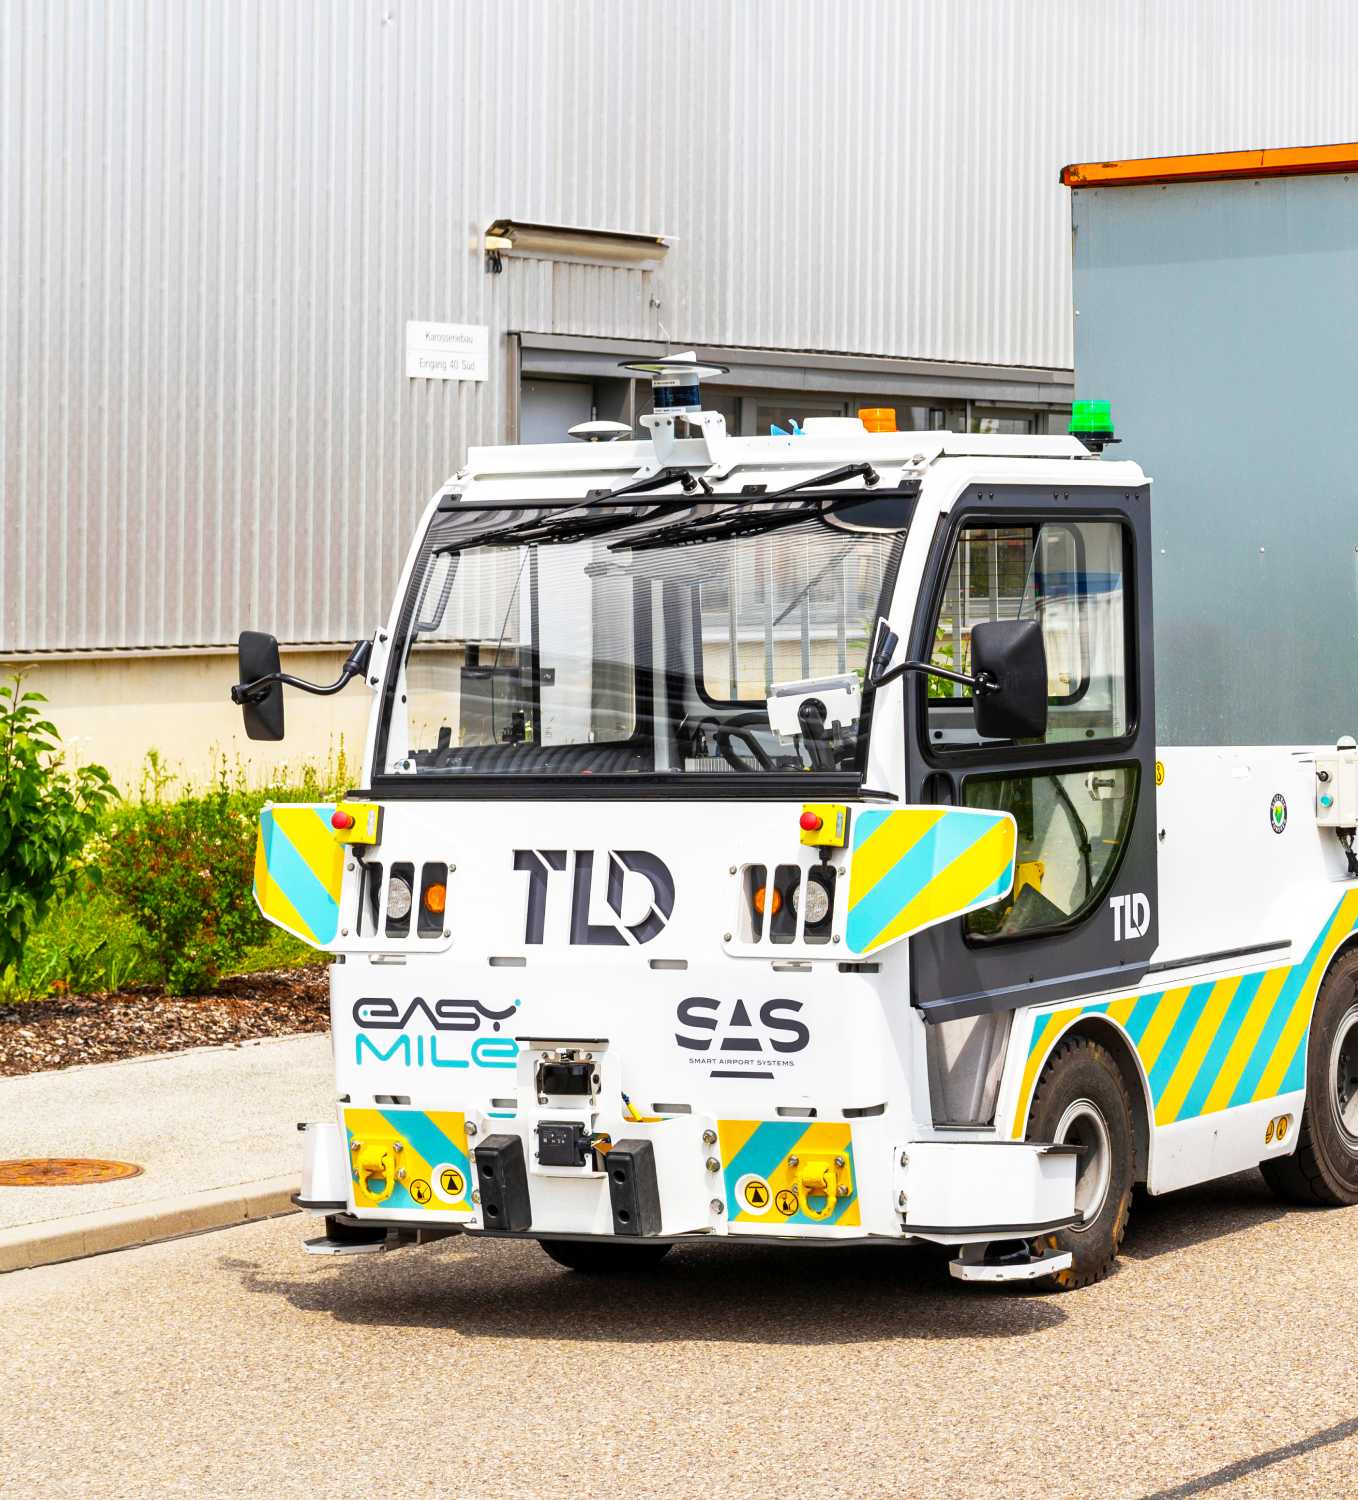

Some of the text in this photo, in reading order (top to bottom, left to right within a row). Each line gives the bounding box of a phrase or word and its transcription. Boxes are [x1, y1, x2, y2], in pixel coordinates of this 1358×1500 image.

[512, 849, 675, 945] TLD
[1109, 892, 1151, 942] TLD
[675, 996, 810, 1053] SAS
[718, 1058, 754, 1066] AIRPORT
[756, 1059, 795, 1067] SYSTEMS
